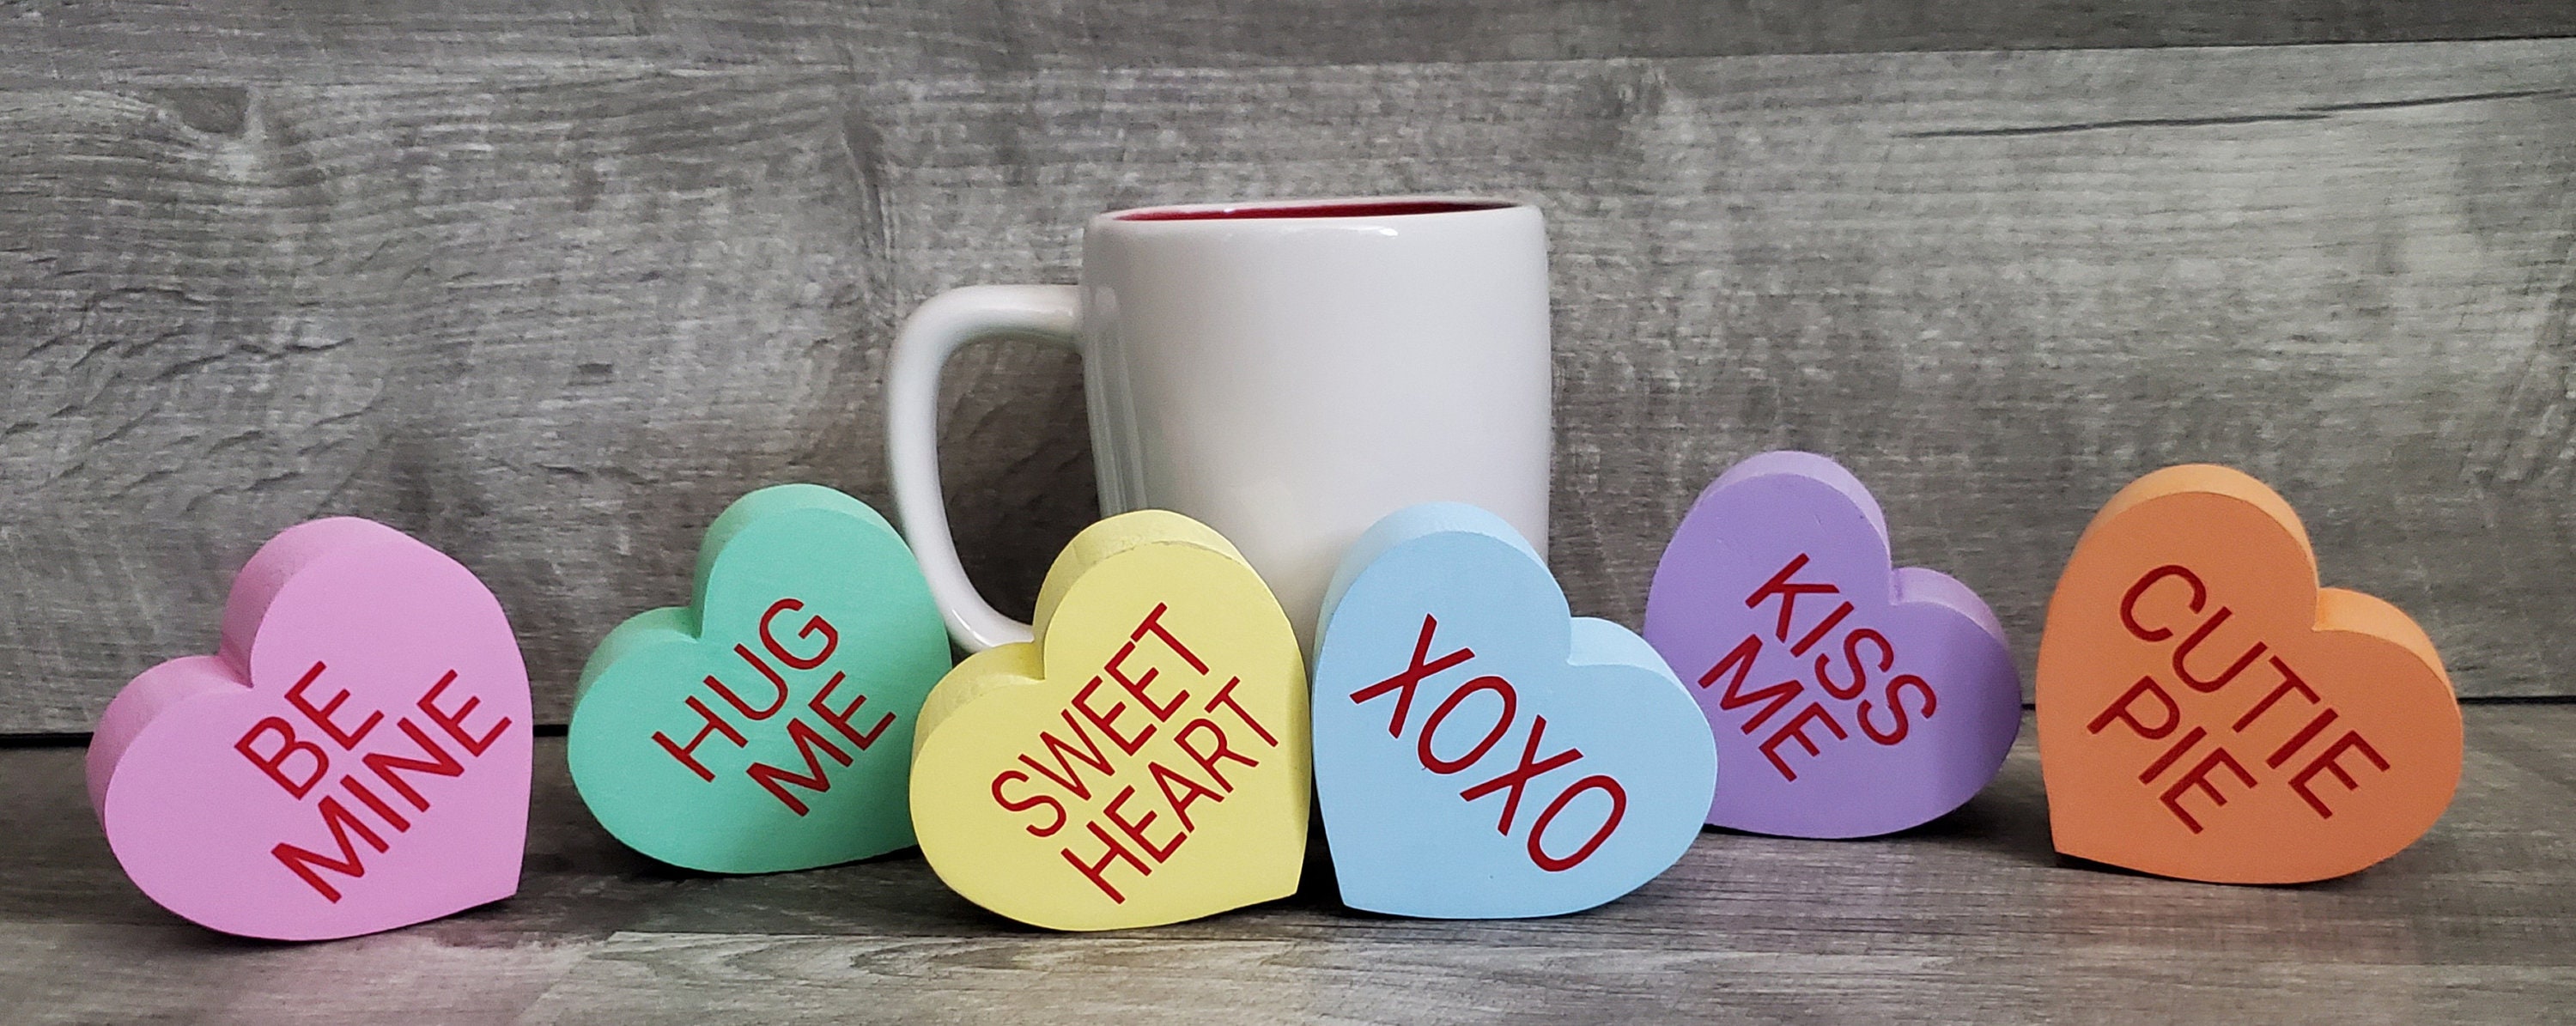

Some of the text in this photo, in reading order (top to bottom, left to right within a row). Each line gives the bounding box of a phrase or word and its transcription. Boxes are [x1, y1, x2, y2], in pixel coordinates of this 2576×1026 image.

[234, 660, 385, 800] BE
[651, 598, 840, 781] HUG
[746, 671, 896, 817] ME
[991, 603, 1210, 838] SWEET
[1350, 613, 1627, 873] XOXO
[1698, 634, 1847, 782] ME
[1746, 553, 1936, 746] KISS
[2119, 563, 2391, 820] CUTIE
[271, 669, 512, 903] MINE
[1061, 677, 1279, 904] HEART
[2086, 675, 2259, 835] PIE
